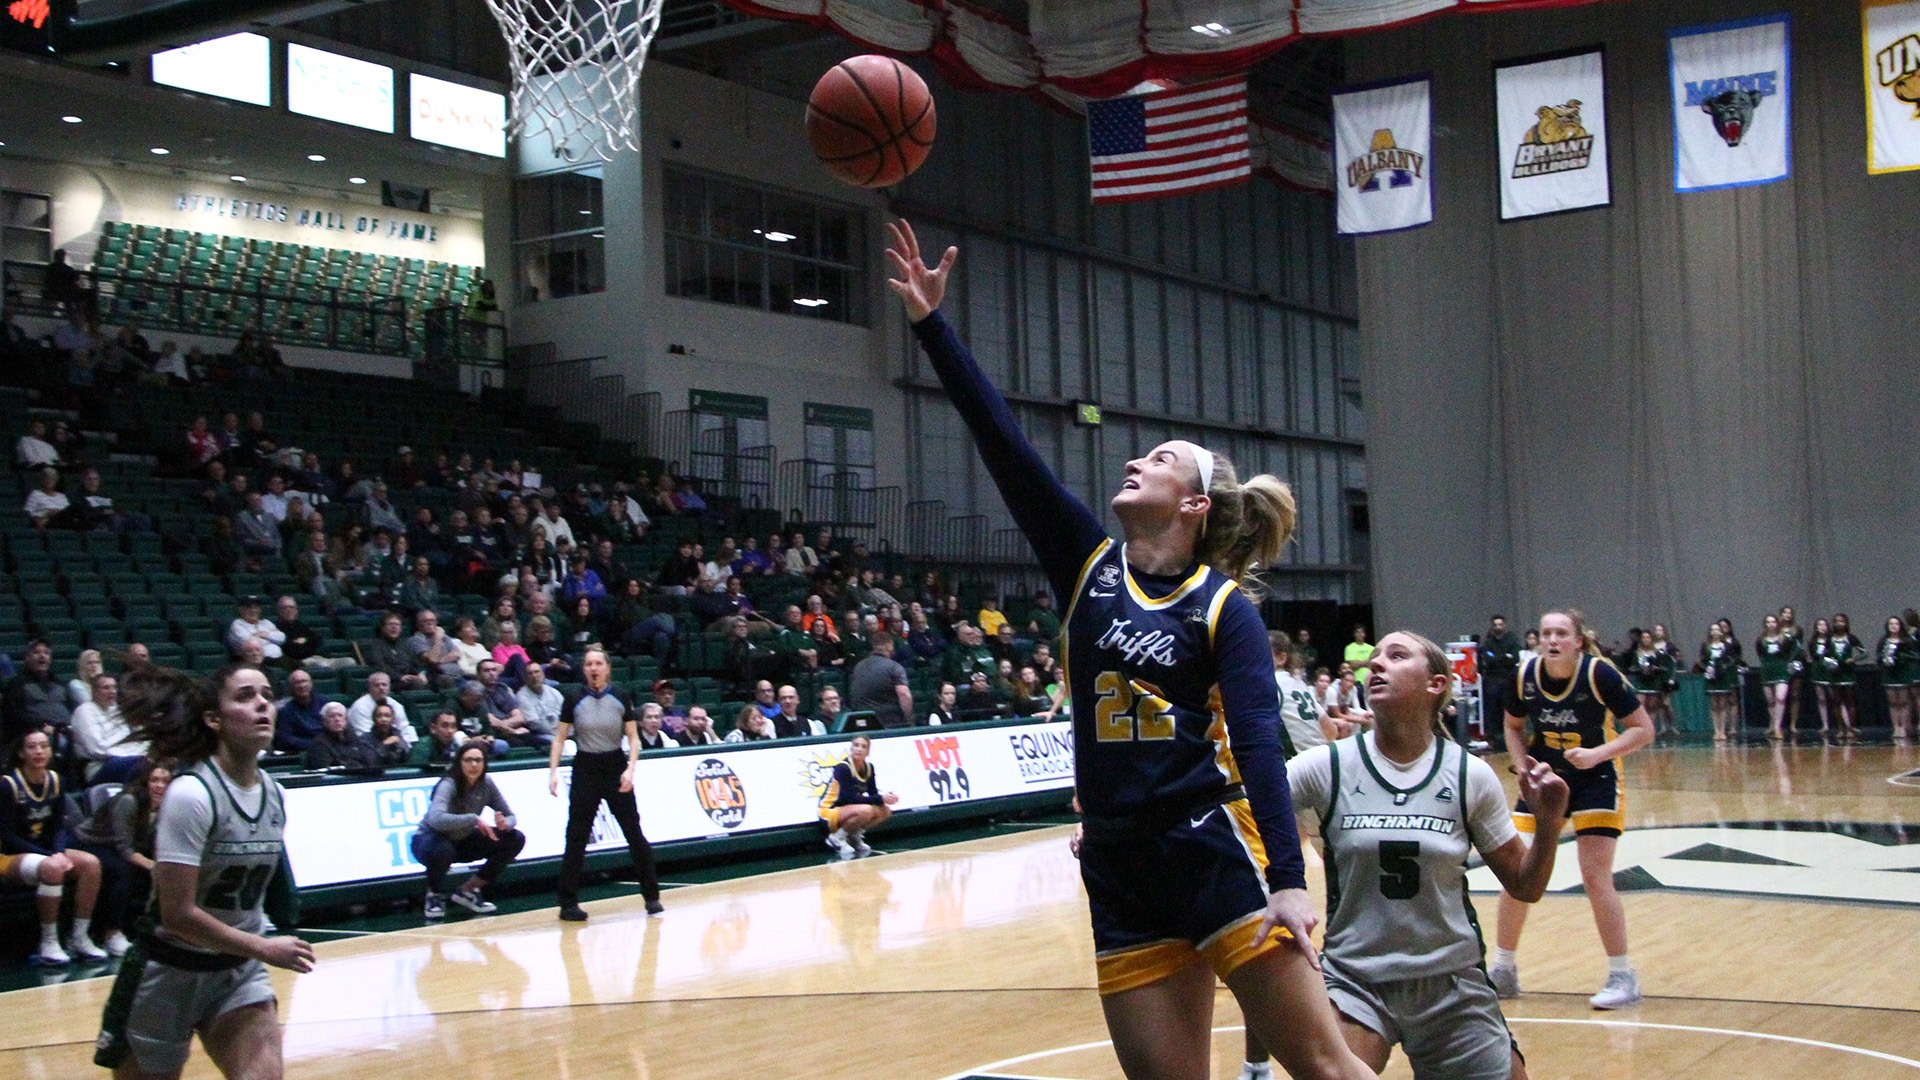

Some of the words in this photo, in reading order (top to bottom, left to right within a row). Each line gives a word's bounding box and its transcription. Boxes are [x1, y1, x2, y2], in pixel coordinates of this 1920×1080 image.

[1516, 136, 1592, 166] BRYANT
[176, 194, 288, 223] ATHLETICS
[297, 208, 346, 230] HALL
[355, 216, 380, 233] OF
[388, 219, 439, 243] FAME
[1094, 617, 1178, 667] Griffs
[1093, 669, 1177, 743] 22
[914, 735, 963, 771] HOT
[928, 766, 971, 801] 92.9
[711, 808, 744, 826] Gold
[1342, 814, 1456, 833] BINGHAMTON
[1378, 840, 1421, 900] 5
